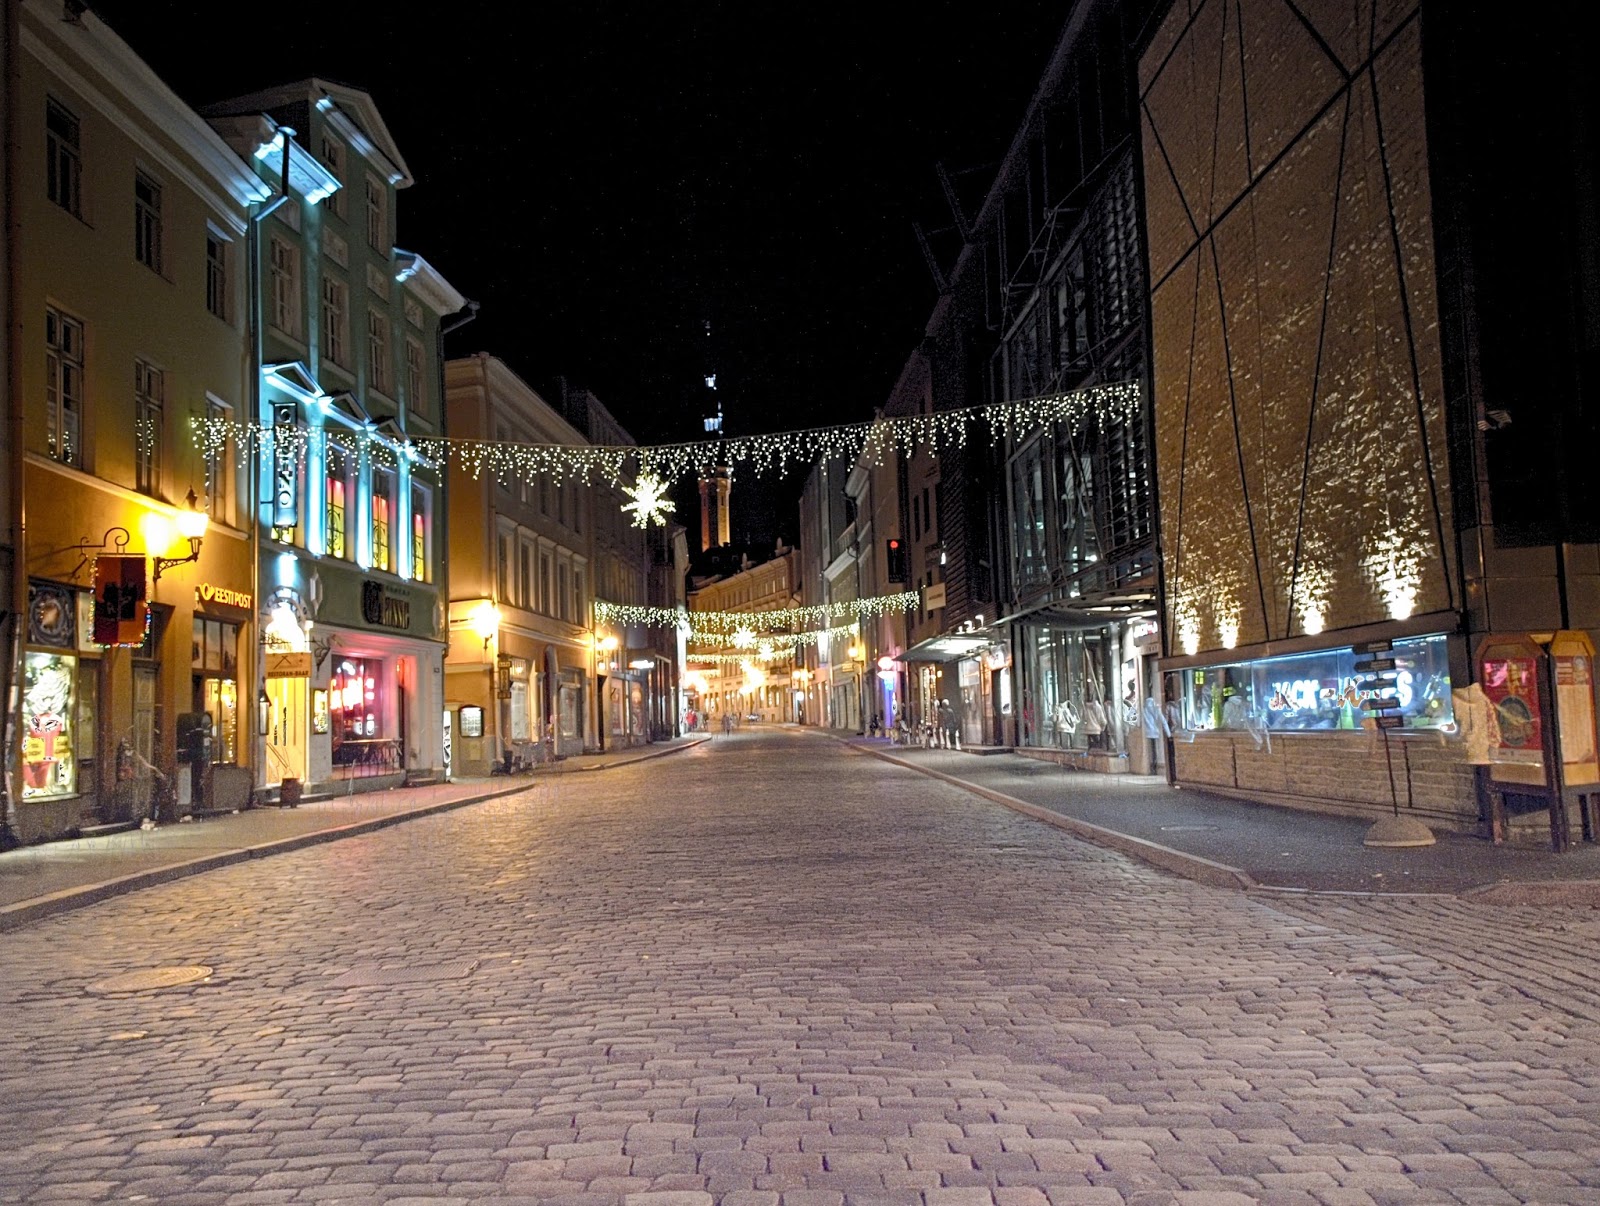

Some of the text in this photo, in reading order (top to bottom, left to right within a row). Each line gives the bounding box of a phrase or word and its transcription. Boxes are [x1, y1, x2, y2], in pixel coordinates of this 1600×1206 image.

[214, 586, 252, 609] EESTI POST
[1268, 670, 1413, 711] JACK JOES
